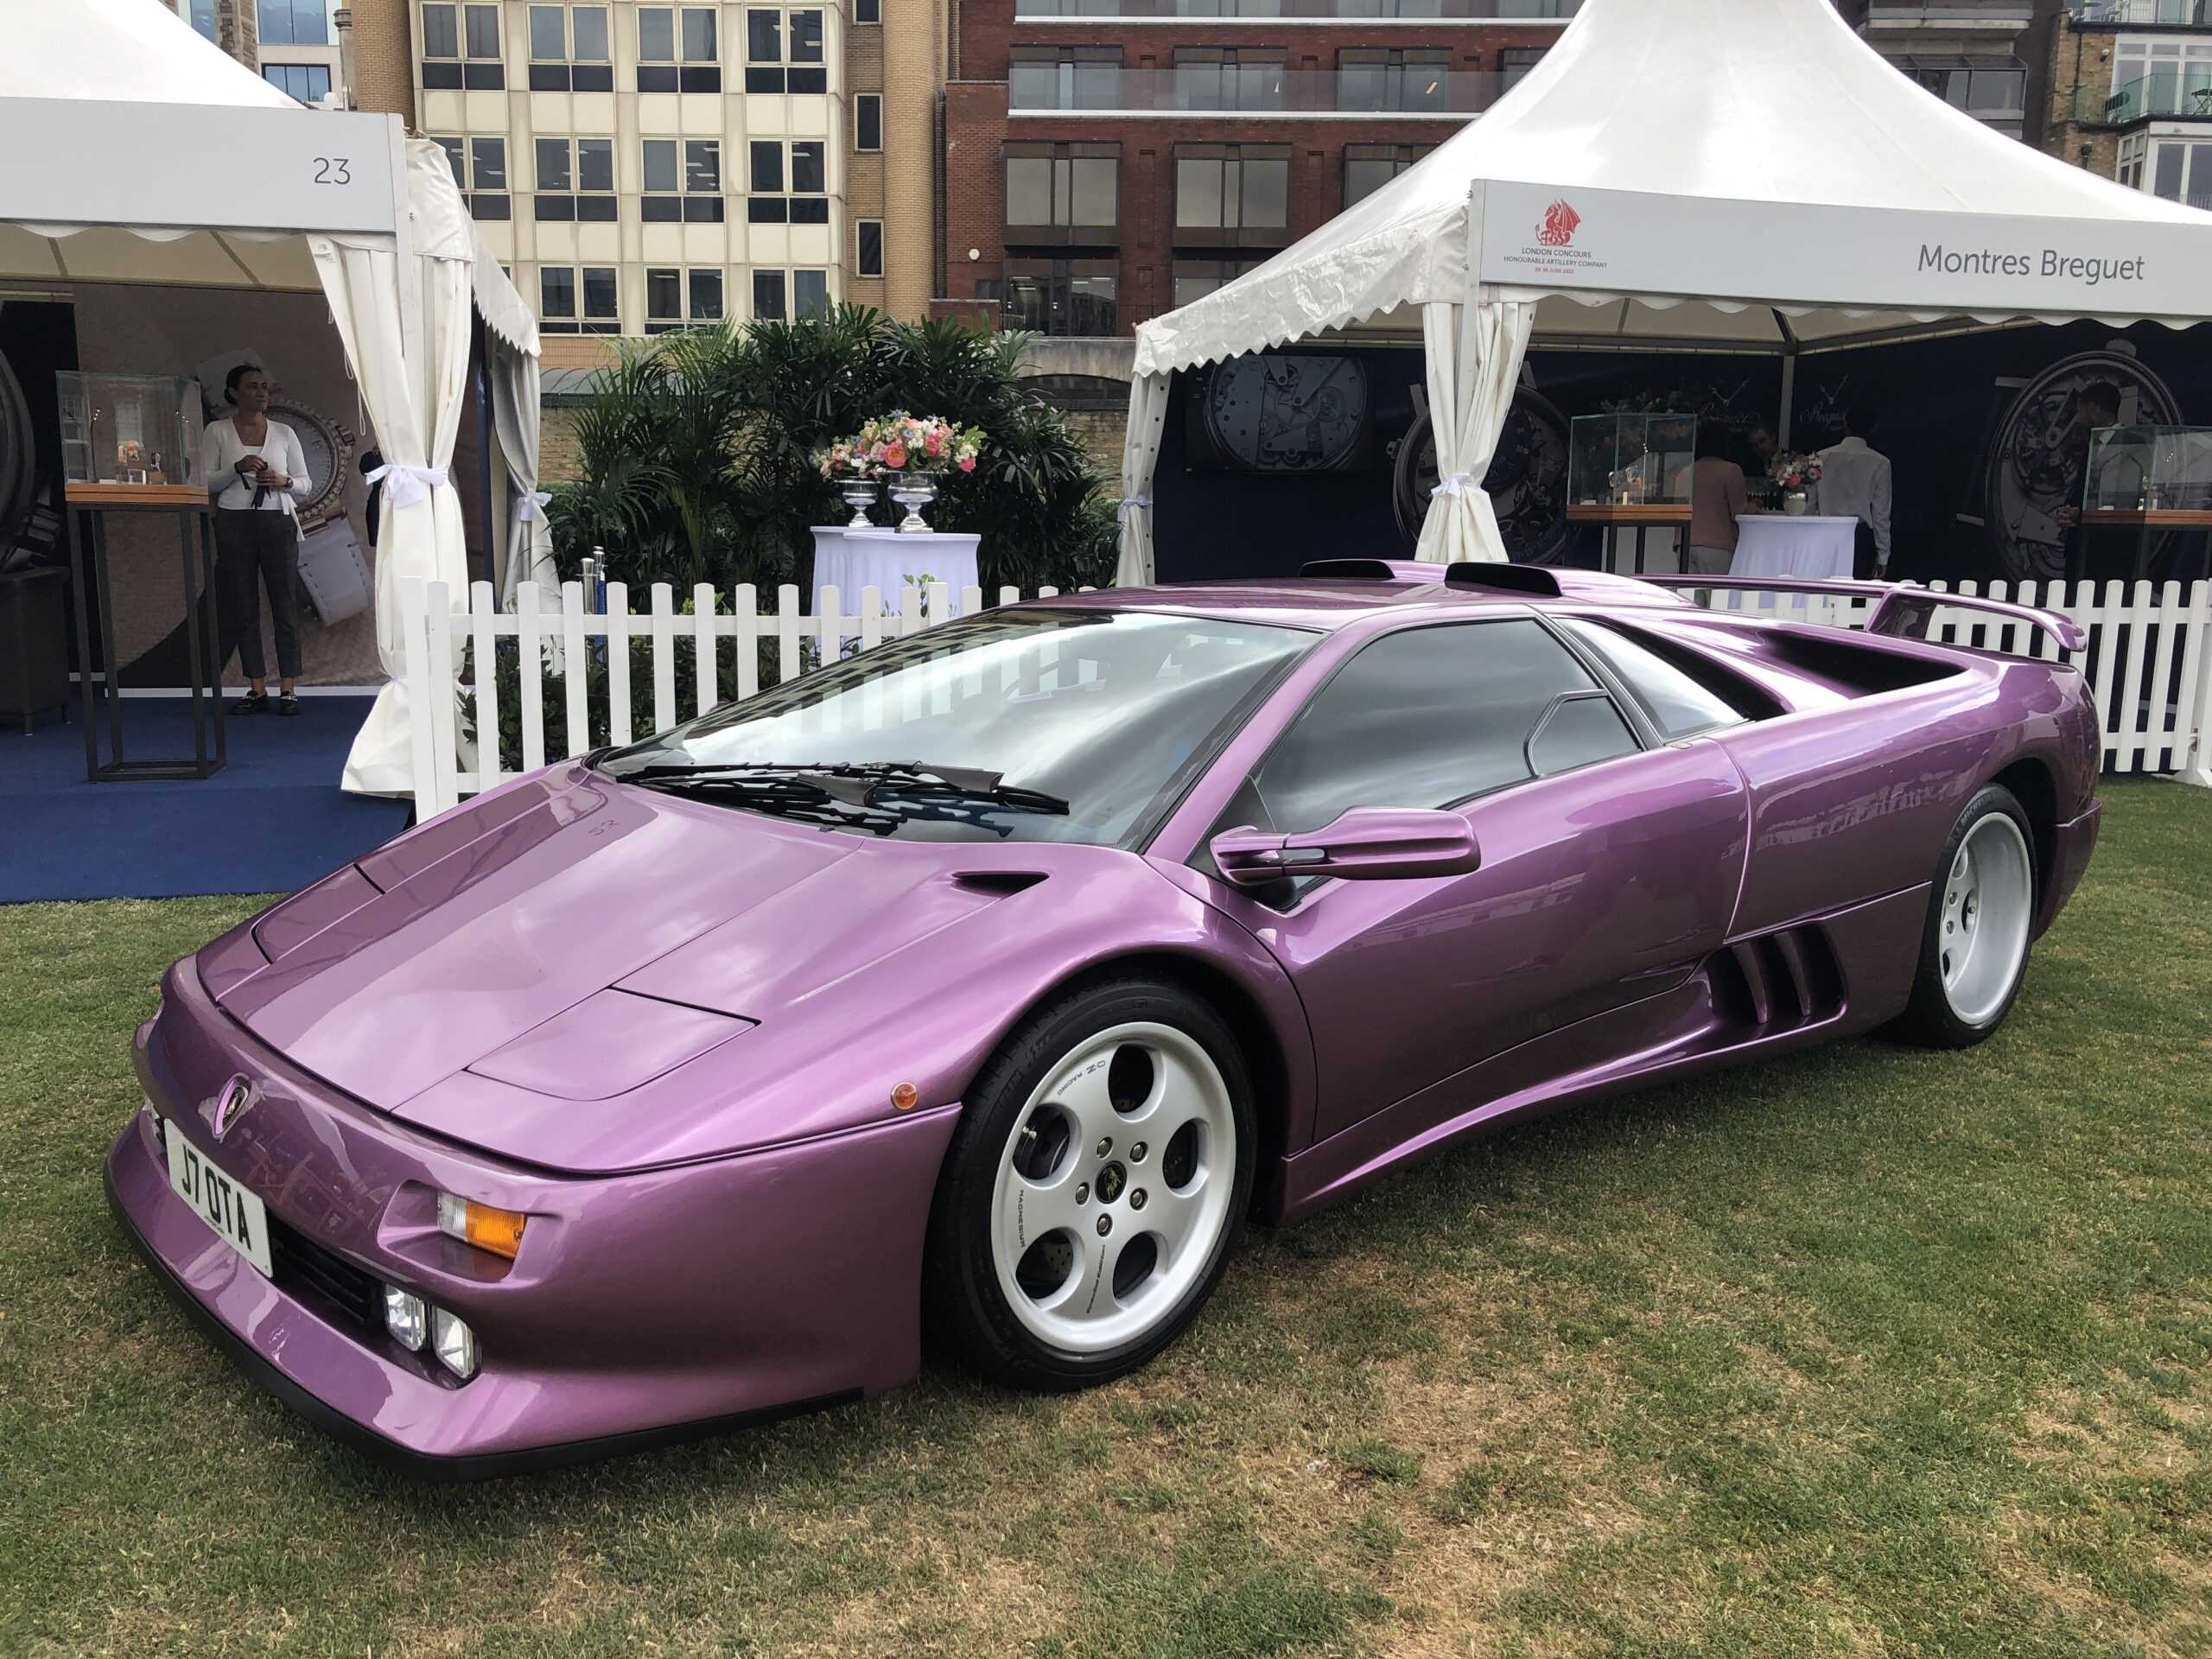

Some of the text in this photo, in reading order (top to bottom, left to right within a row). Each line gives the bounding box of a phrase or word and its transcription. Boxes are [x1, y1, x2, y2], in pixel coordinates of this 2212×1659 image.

[314, 157, 350, 185] 23
[1503, 255, 1545, 264] HONOURABLE
[1546, 258, 1577, 267] ARTILLERY
[1522, 247, 1592, 258] LONDON CONCOURS
[1917, 244, 2145, 285] Montres Breguet
[1086, 1060, 1106, 1074] OZ
[181, 1143, 200, 1205] J7
